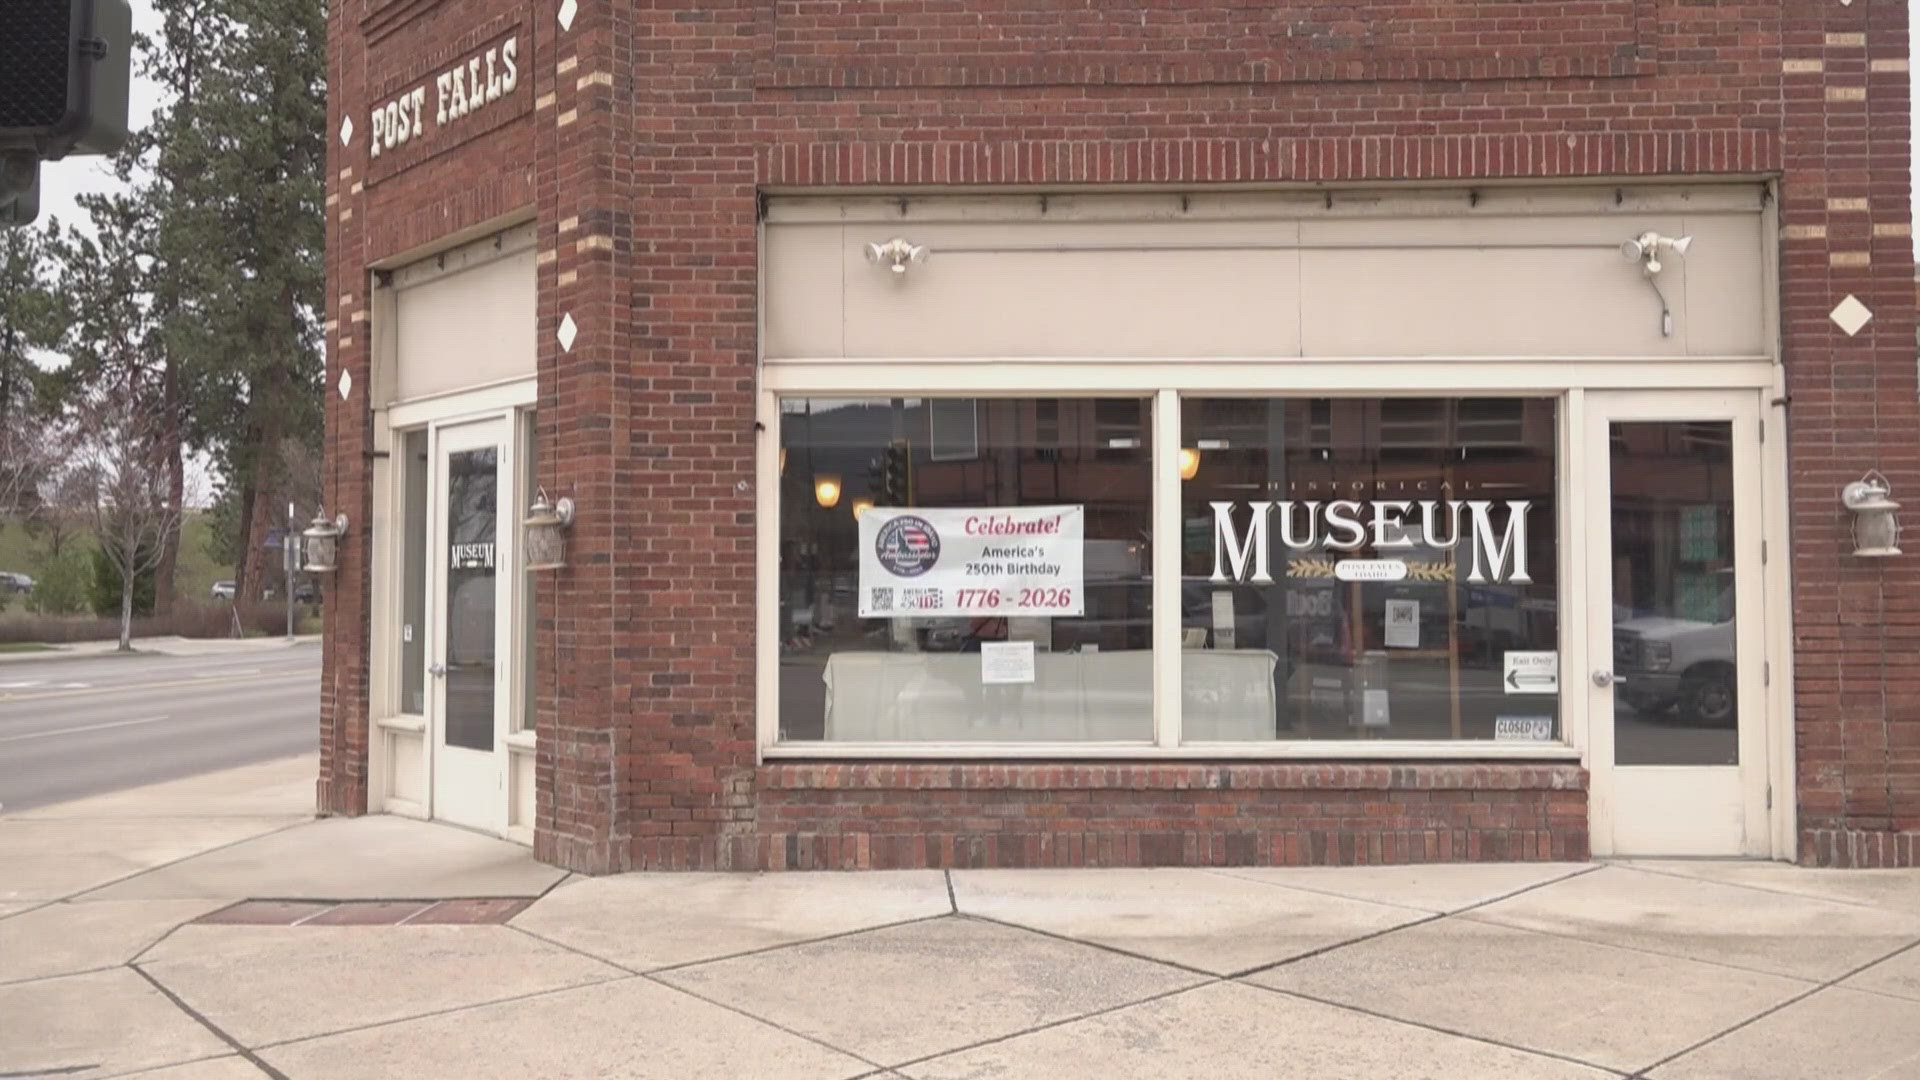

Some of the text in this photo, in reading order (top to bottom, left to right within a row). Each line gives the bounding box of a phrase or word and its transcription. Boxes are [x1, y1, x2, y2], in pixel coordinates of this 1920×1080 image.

[371, 36, 518, 158] POST FALLS
[1266, 479, 1475, 492] HISTORICAL
[965, 514, 1062, 535] Celebrate!
[1209, 499, 1534, 584] MUSEUM
[451, 543, 493, 569] MUSEUM
[981, 545, 1045, 559] America's
[965, 563, 1061, 578] 250th Birthday
[956, 588, 1000, 609] 1776
[1018, 588, 1072, 609] 2026
[1512, 655, 1553, 667] Exit Only
[1497, 720, 1531, 733] CLOSED
